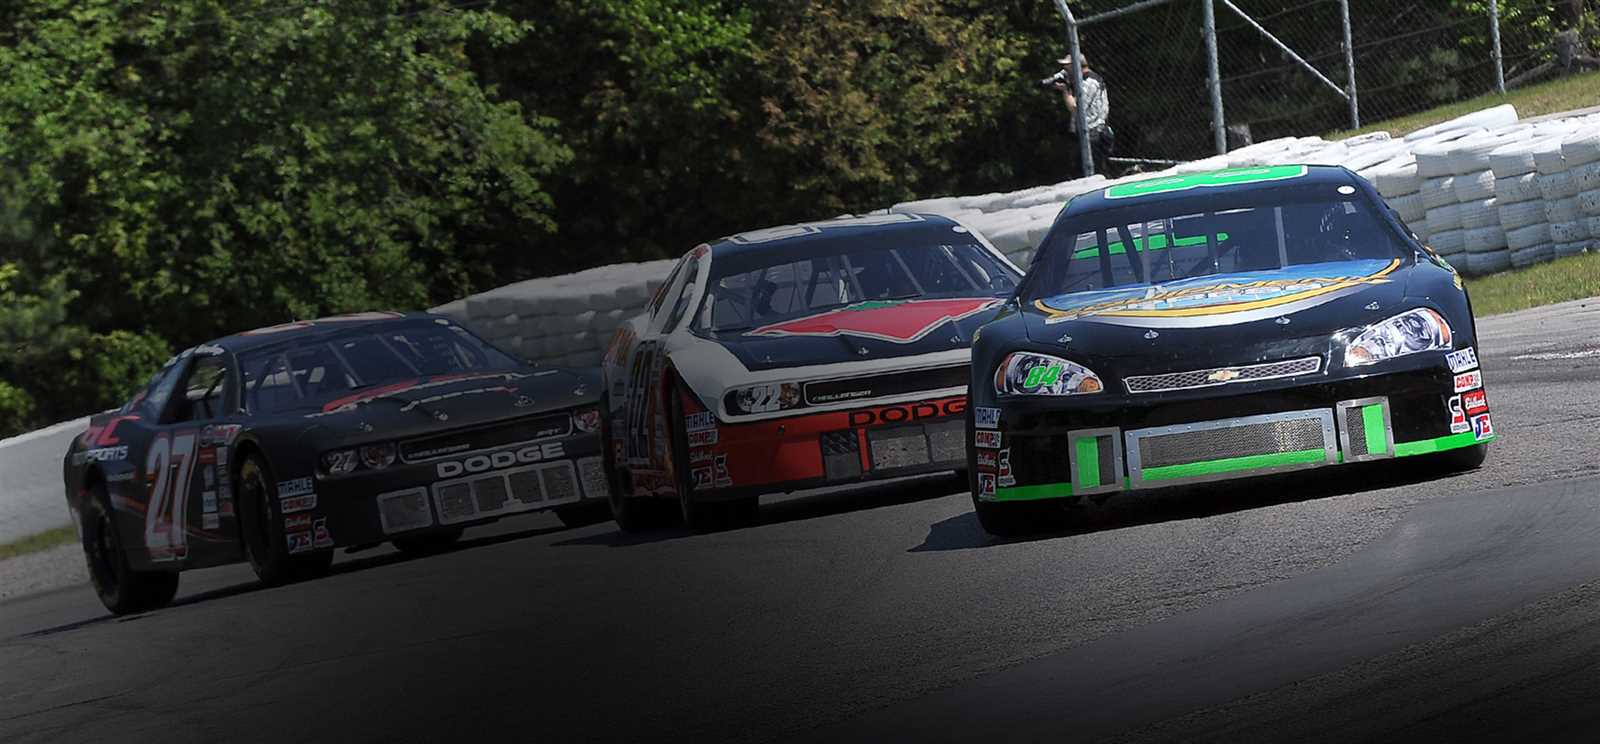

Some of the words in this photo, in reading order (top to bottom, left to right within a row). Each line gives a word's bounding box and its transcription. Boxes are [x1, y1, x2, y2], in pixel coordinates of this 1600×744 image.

[1024, 366, 1062, 387] 84
[751, 383, 780, 412] 22
[329, 450, 354, 472] 27
[437, 441, 566, 478] DODGE
[146, 430, 199, 561] 27
